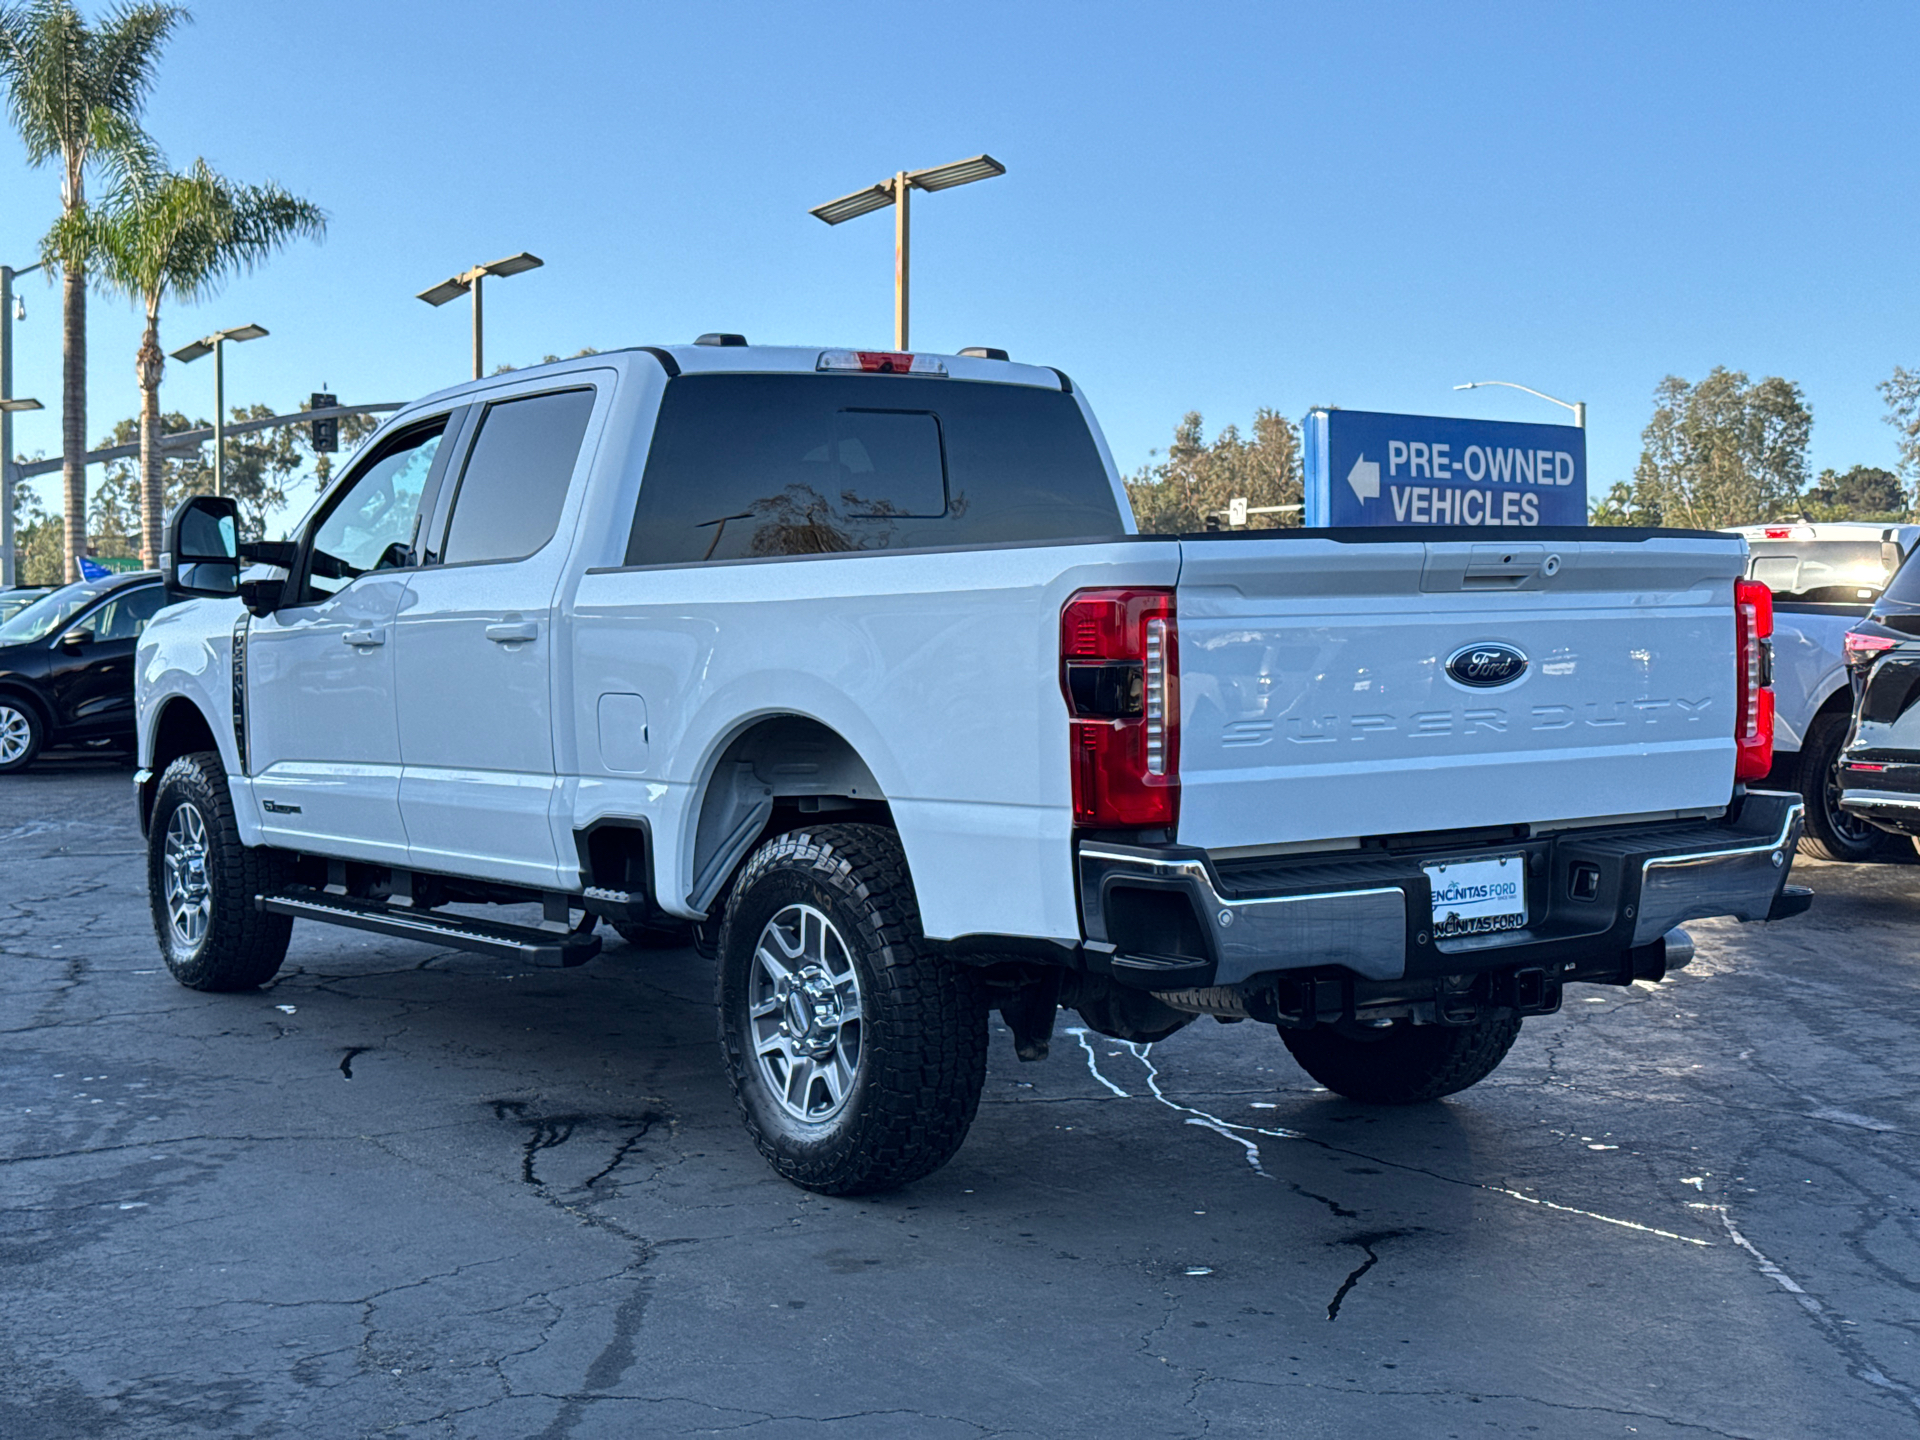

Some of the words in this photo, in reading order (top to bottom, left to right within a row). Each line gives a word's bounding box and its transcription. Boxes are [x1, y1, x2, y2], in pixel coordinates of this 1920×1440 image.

[1388, 440, 1575, 486] PRE-OWNED
[1390, 485, 1540, 526] VEHICLES
[1467, 651, 1512, 677] Ford
[1222, 707, 1508, 748] SUPER
[1531, 696, 1713, 731] DUTY
[1489, 882, 1516, 896] FORD
[1433, 916, 1490, 935] NCINITAS
[1492, 913, 1523, 929] FORD
